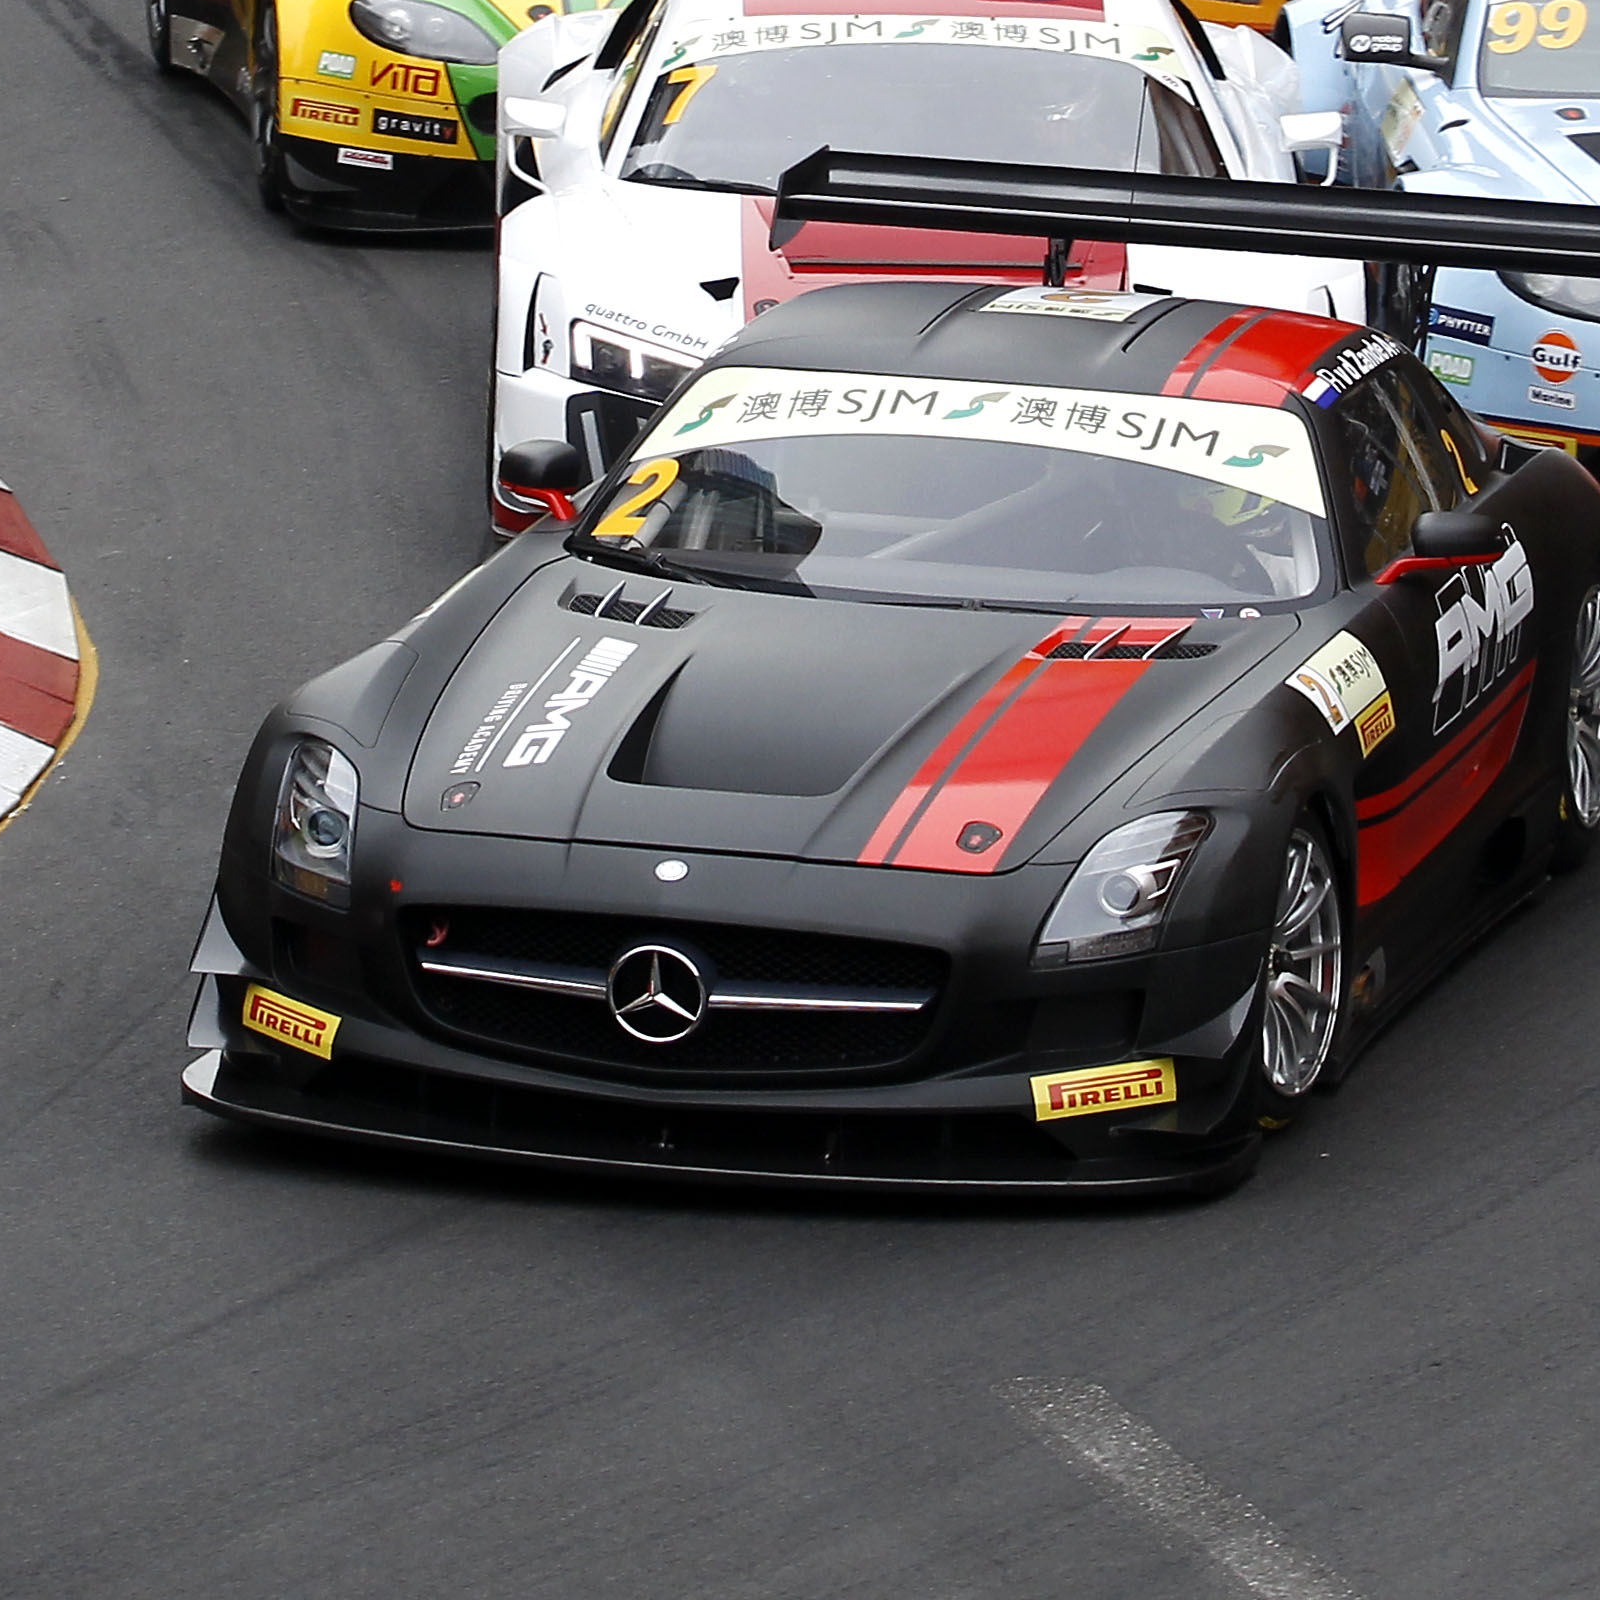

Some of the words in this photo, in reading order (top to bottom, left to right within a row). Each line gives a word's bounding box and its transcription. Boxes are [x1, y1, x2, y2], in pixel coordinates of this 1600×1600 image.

[800, 20, 884, 43] SJM
[1040, 26, 1124, 55] SJM
[290, 98, 360, 127] PIRELLI
[661, 65, 720, 126] 7
[377, 116, 453, 140] gravity
[584, 302, 648, 331] quattro
[650, 324, 709, 349] GmbH
[1437, 313, 1492, 337] PHYTTER
[1531, 346, 1583, 369] Gulf
[740, 389, 829, 424] 澳博
[837, 386, 940, 419] SJM
[1011, 395, 1108, 435] 澳博
[1115, 412, 1222, 457] SJM
[1441, 428, 1480, 497] 2
[590, 458, 681, 538] 2
[1435, 538, 1536, 688] AMG
[502, 670, 610, 768] AMG
[1296, 673, 1344, 726] 2
[450, 725, 496, 775] ACADEMY
[1360, 702, 1392, 750] PIRELLI
[249, 993, 327, 1048] PIRELLI
[1048, 1068, 1163, 1111] PIRELLI
